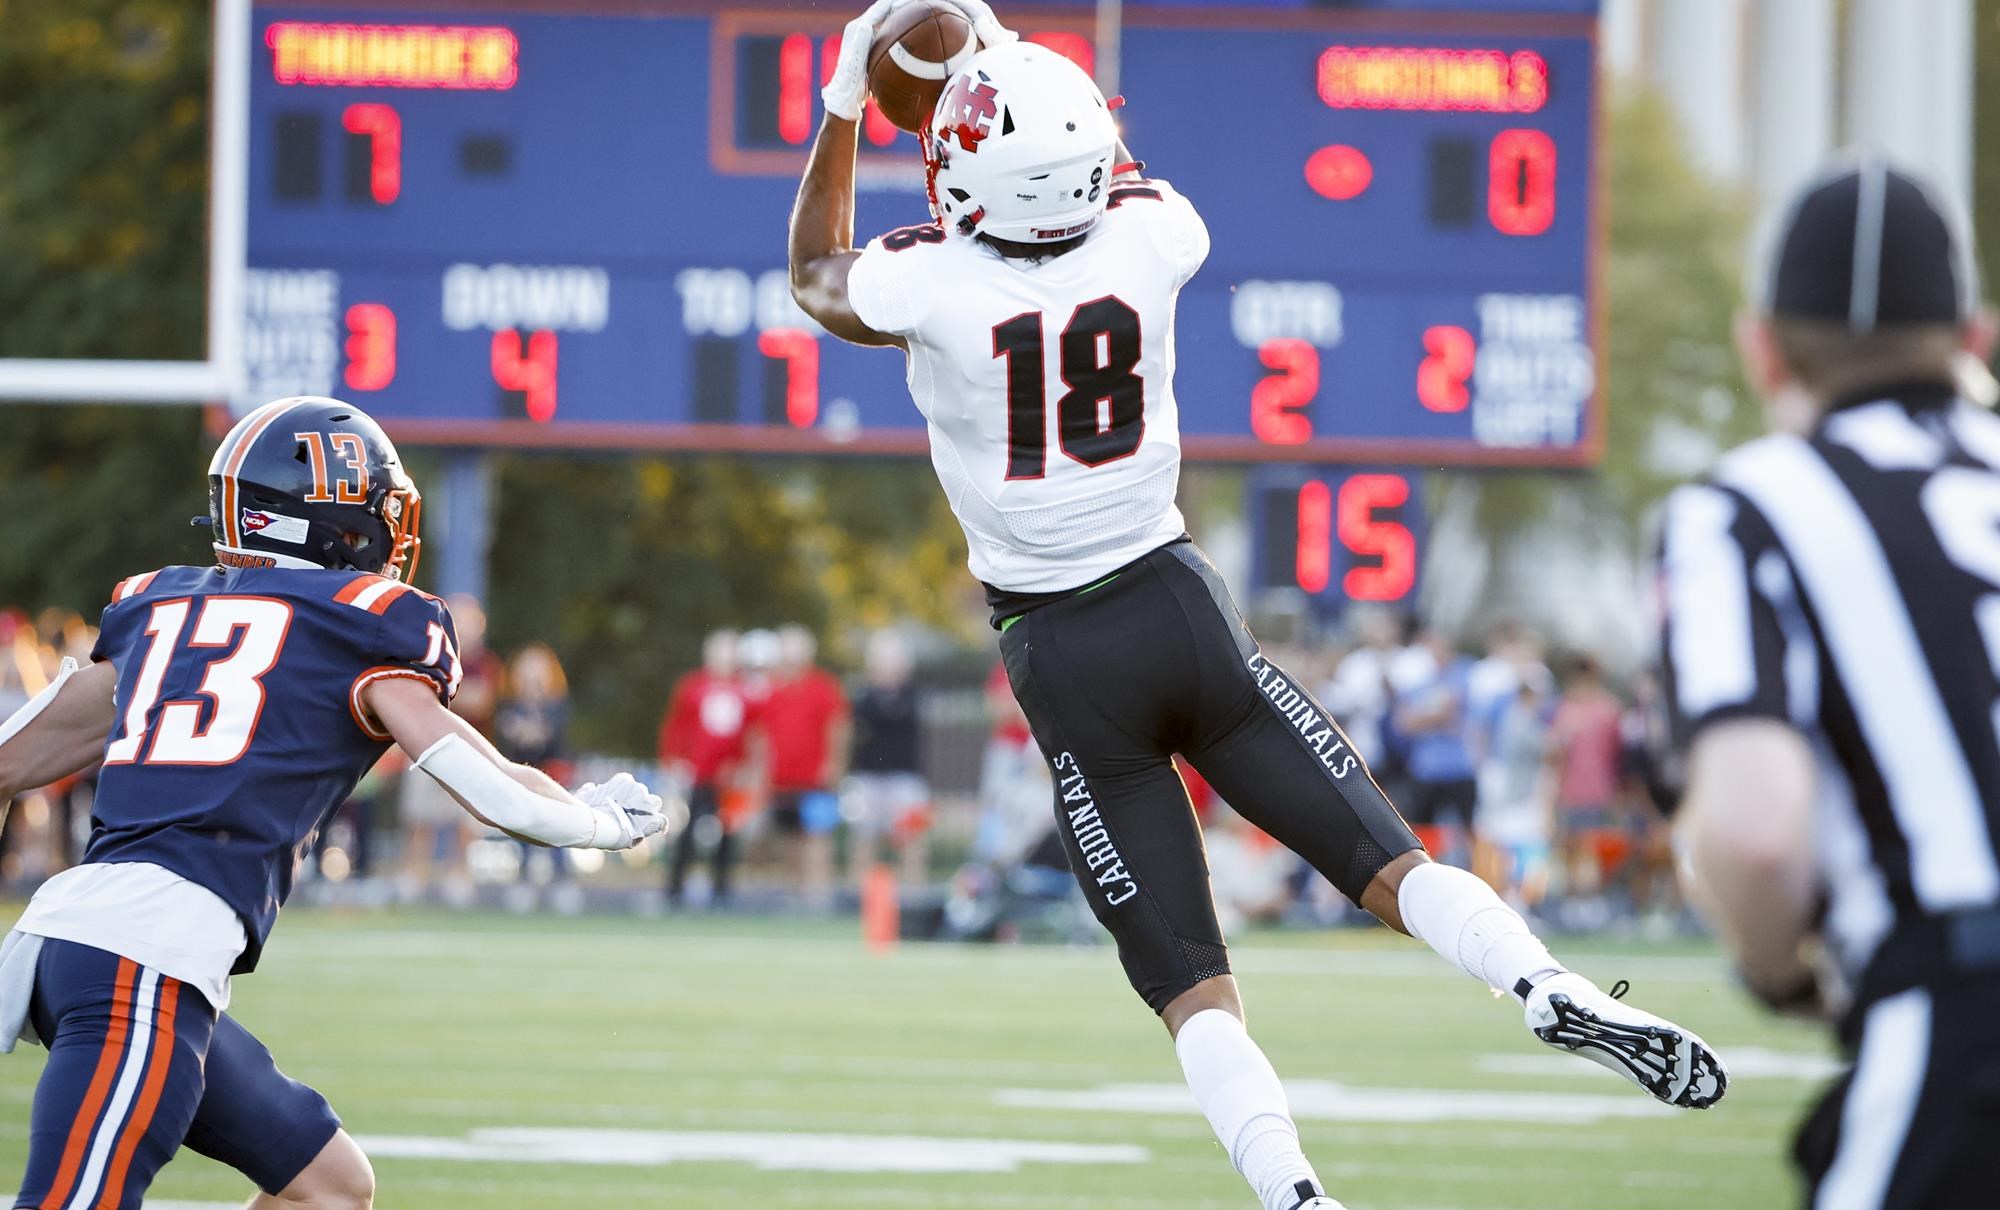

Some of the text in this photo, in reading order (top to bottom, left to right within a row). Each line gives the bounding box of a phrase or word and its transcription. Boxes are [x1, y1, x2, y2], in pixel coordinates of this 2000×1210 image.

[342, 103, 400, 204] 7
[1488, 129, 1557, 236] 0
[344, 303, 397, 391] 3
[441, 264, 609, 332] DOWN
[674, 267, 752, 337] TO
[491, 327, 558, 424] 4
[757, 327, 819, 428] 7
[991, 294, 1145, 482] 18
[1251, 337, 1320, 446] 2
[1417, 325, 1476, 413] 2
[293, 431, 371, 505] 13
[215, 549, 277, 568] UNDER
[245, 515, 267, 527] NCAA
[1296, 474, 1416, 600] 15
[103, 595, 294, 766] 13
[1248, 653, 1357, 780] CARDINALS
[1053, 751, 1139, 906] CARDINALS
